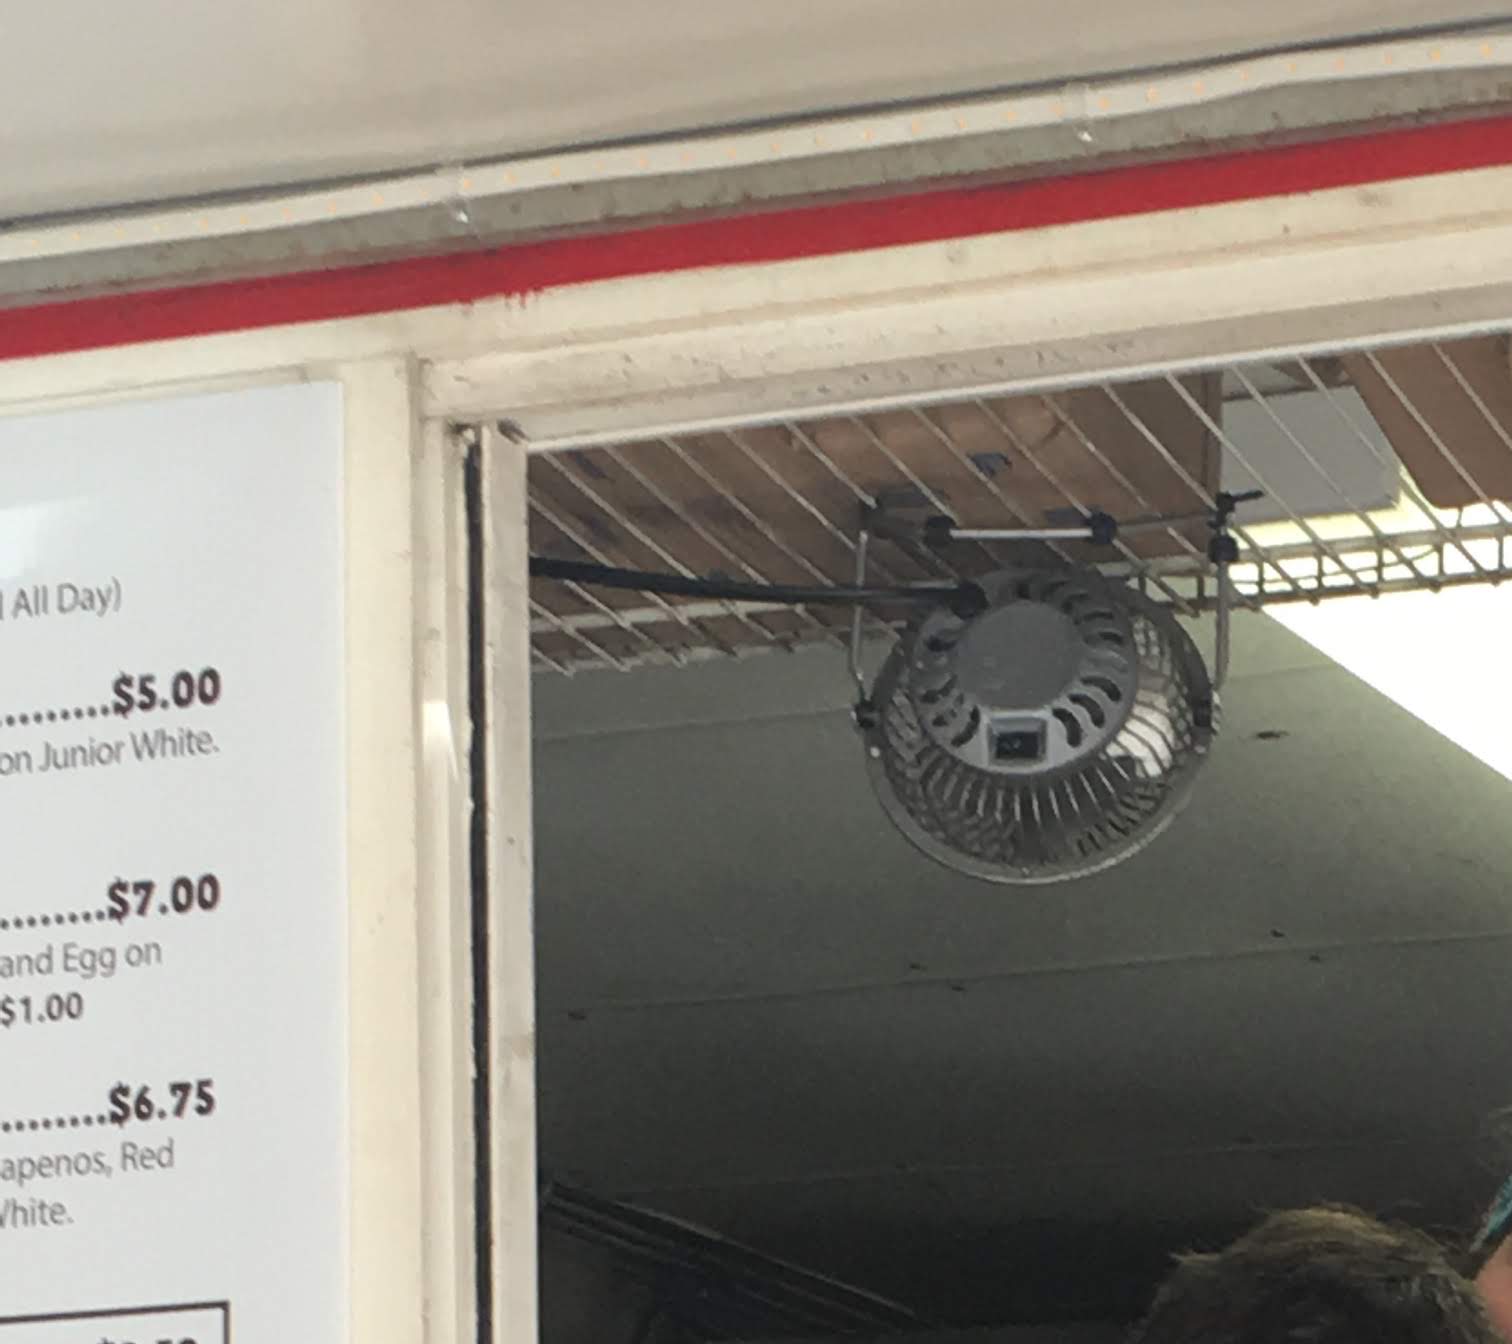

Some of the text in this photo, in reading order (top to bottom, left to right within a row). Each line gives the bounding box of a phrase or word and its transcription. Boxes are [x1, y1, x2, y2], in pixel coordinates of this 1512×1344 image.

[12, 577, 122, 619] All Day)
[39, 737, 123, 774] Junior
[130, 729, 220, 762] White.
[0, 940, 162, 981] and Egg on
[121, 1138, 175, 1172] Red
